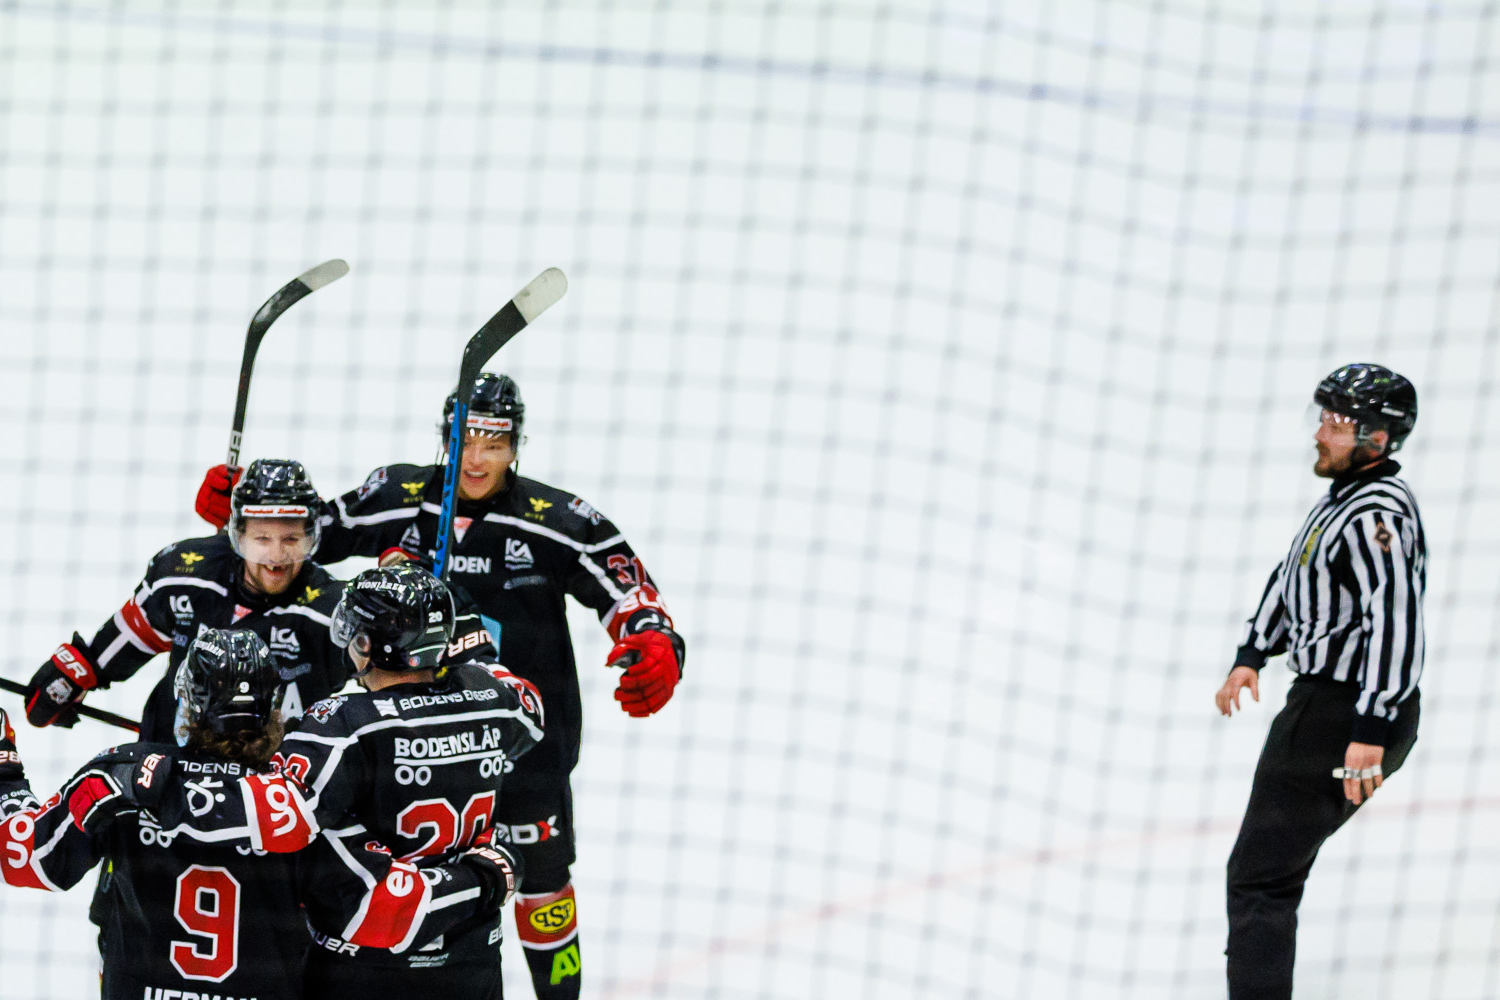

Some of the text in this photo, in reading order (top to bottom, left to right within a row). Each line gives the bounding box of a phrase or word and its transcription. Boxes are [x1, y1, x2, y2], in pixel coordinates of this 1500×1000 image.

[428, 611, 443, 623] 20
[240, 681, 250, 693] 9
[399, 692, 464, 711] BODENS
[396, 790, 497, 861] 20
[169, 864, 241, 983] 9
